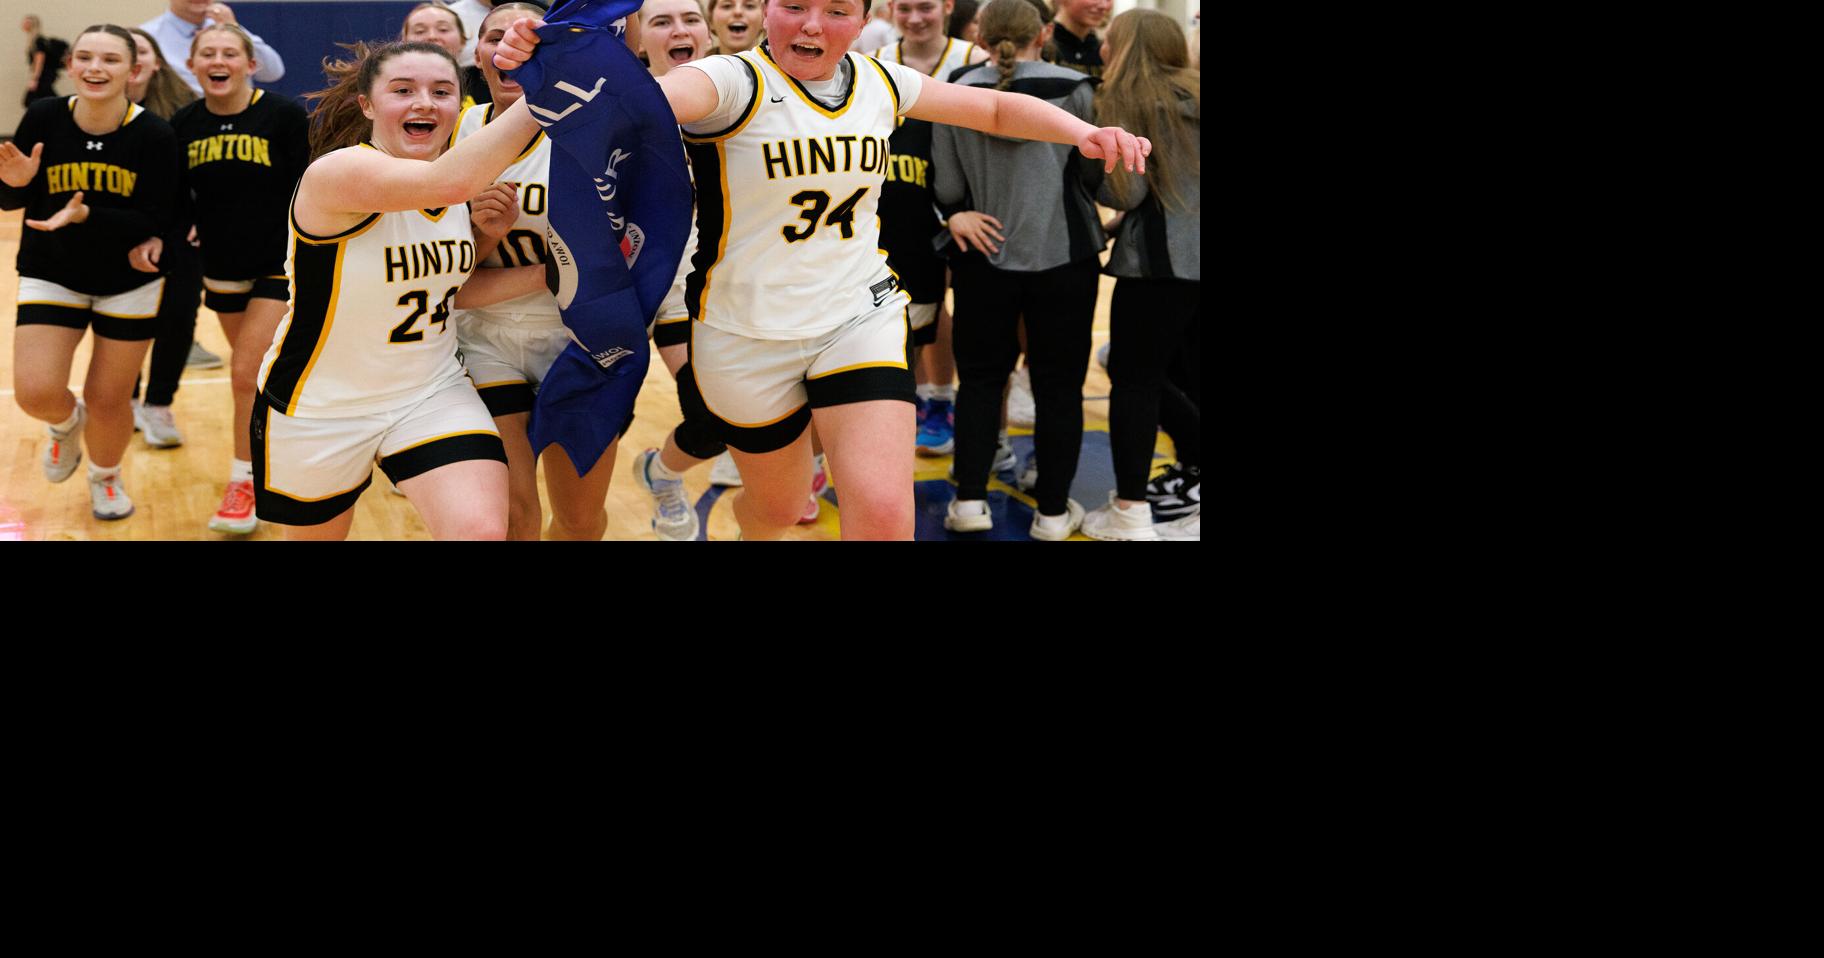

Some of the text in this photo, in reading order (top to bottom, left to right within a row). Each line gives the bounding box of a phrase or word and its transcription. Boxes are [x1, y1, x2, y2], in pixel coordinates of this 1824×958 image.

[187, 133, 272, 169] HINTON
[762, 135, 890, 180] HINTON
[886, 153, 929, 188] TON
[46, 161, 138, 198] HINTON
[781, 186, 869, 243] 34
[384, 240, 477, 283] HINTO
